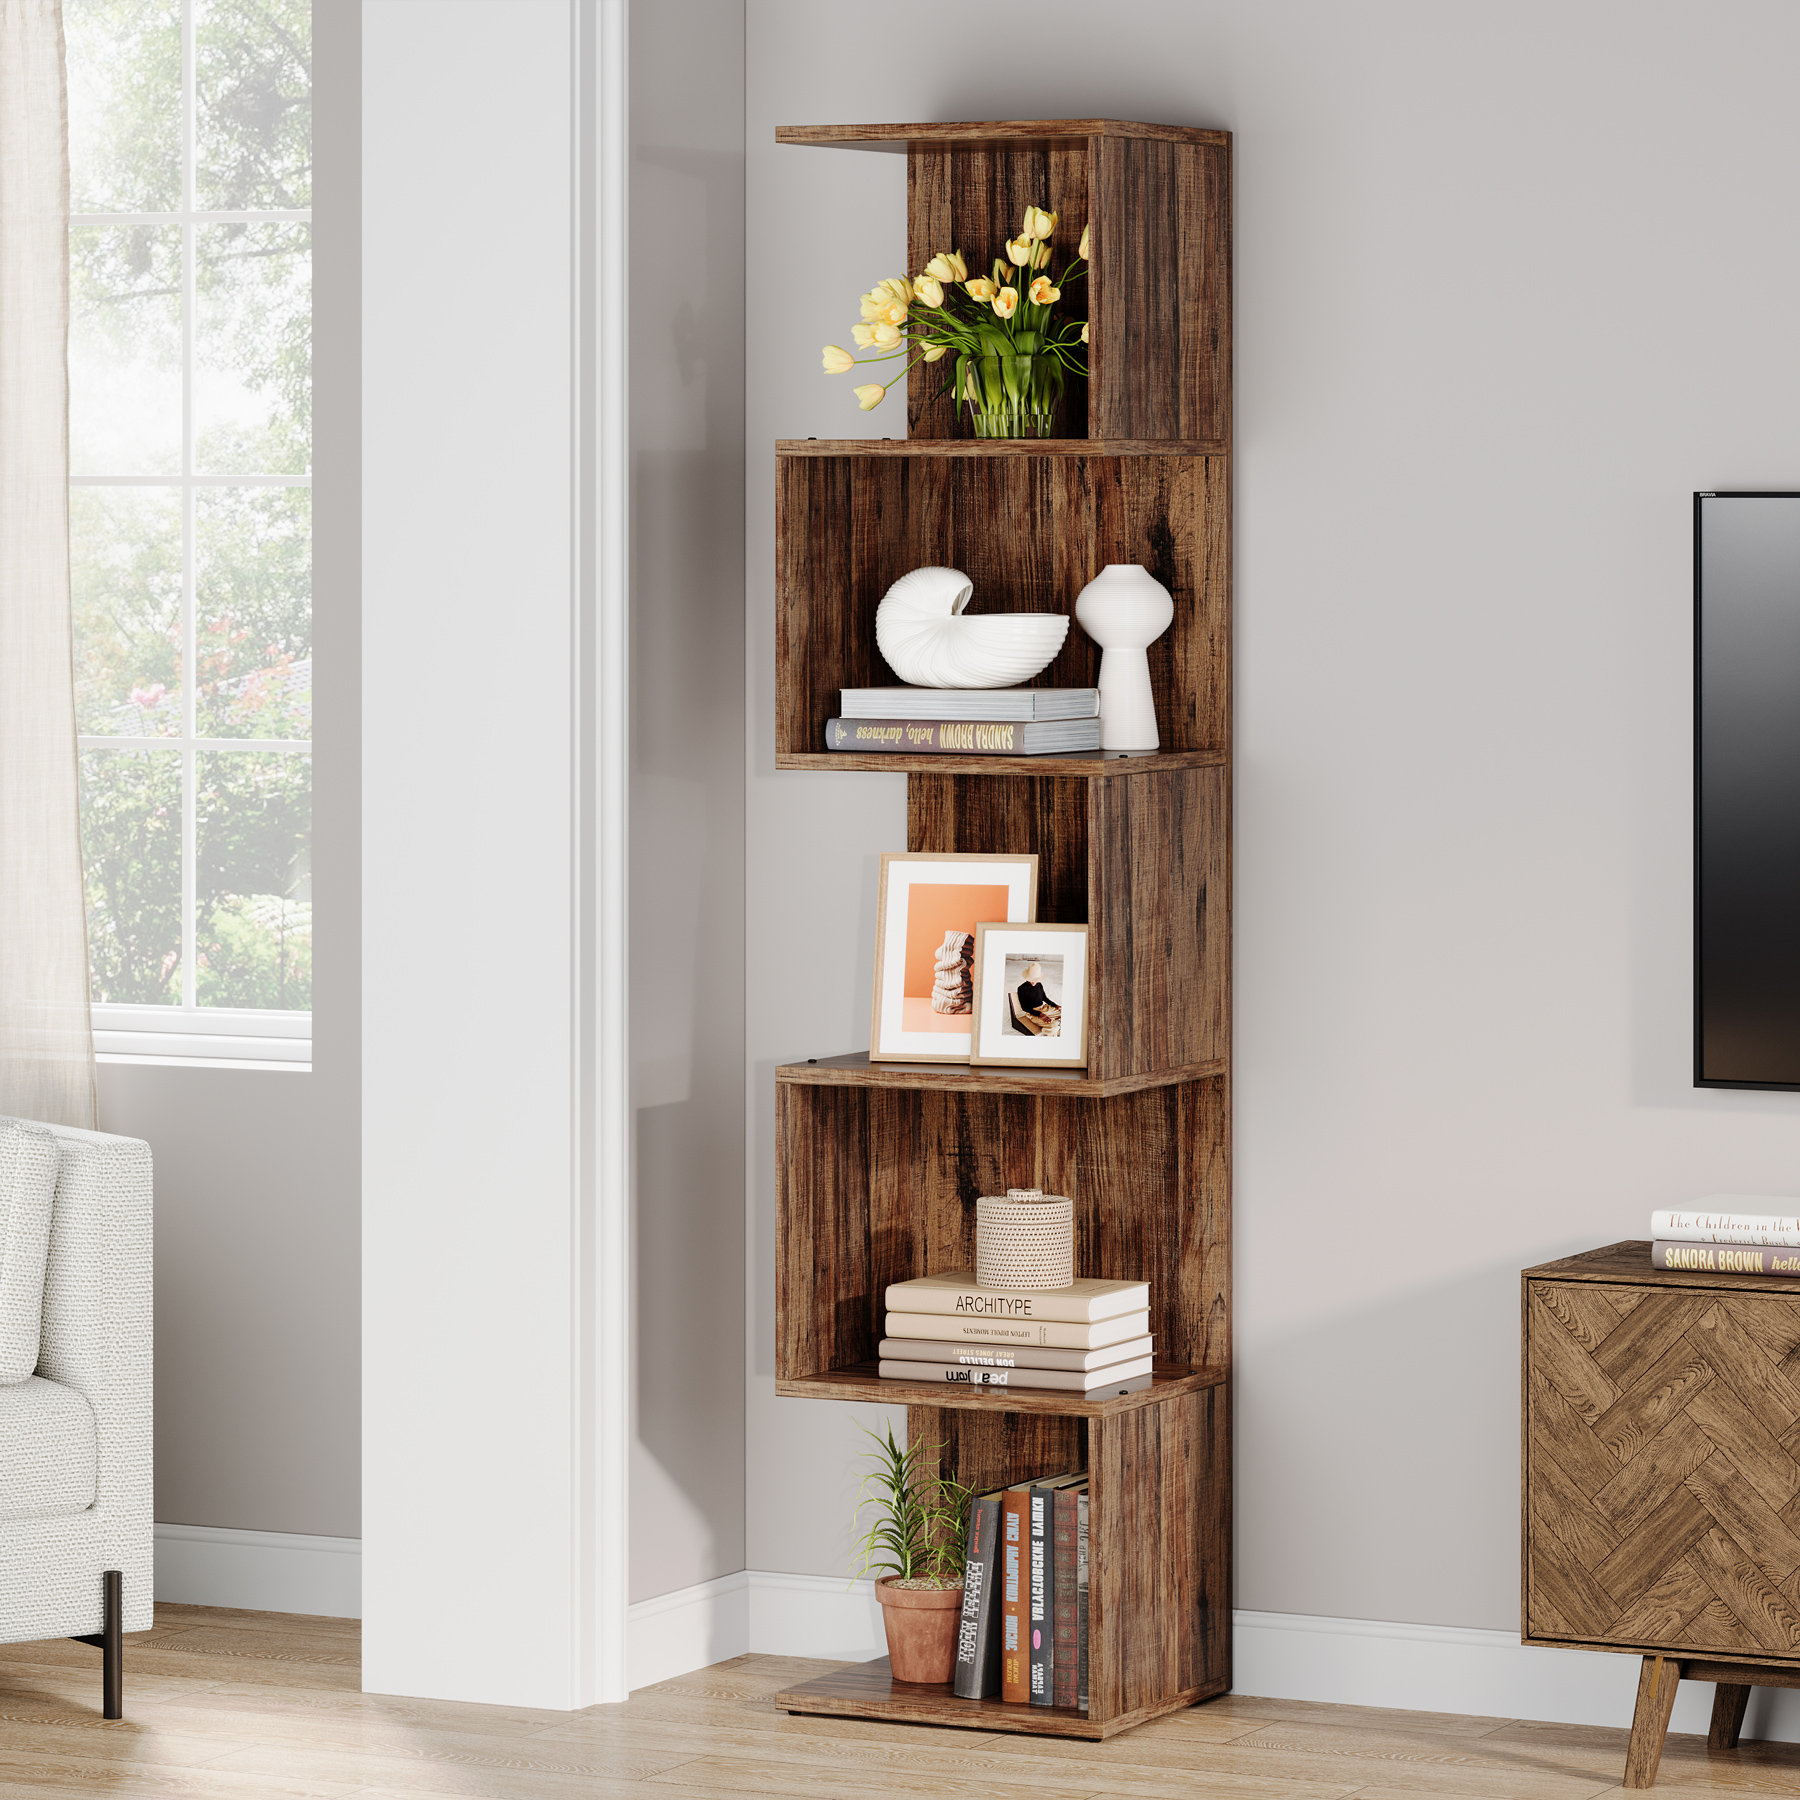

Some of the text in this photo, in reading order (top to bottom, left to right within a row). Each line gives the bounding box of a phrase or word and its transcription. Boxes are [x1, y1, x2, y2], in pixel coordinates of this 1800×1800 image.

[856, 725, 902, 743] darkness
[906, 724, 933, 745] hello,
[940, 724, 1013, 750] SANDRA BROWN
[1669, 1213, 1690, 1228] The
[1696, 1215, 1750, 1231] Children
[1756, 1222, 1767, 1231] in
[1773, 1217, 1792, 1232] the
[1665, 1247, 1764, 1272] SANDRA BROWN
[955, 1295, 1032, 1316] ARCHITYPE
[990, 1329, 1010, 1337] DIPOLE
[959, 1356, 1015, 1367] DON DELILLO
[946, 1369, 1008, 1385] pearl jam
